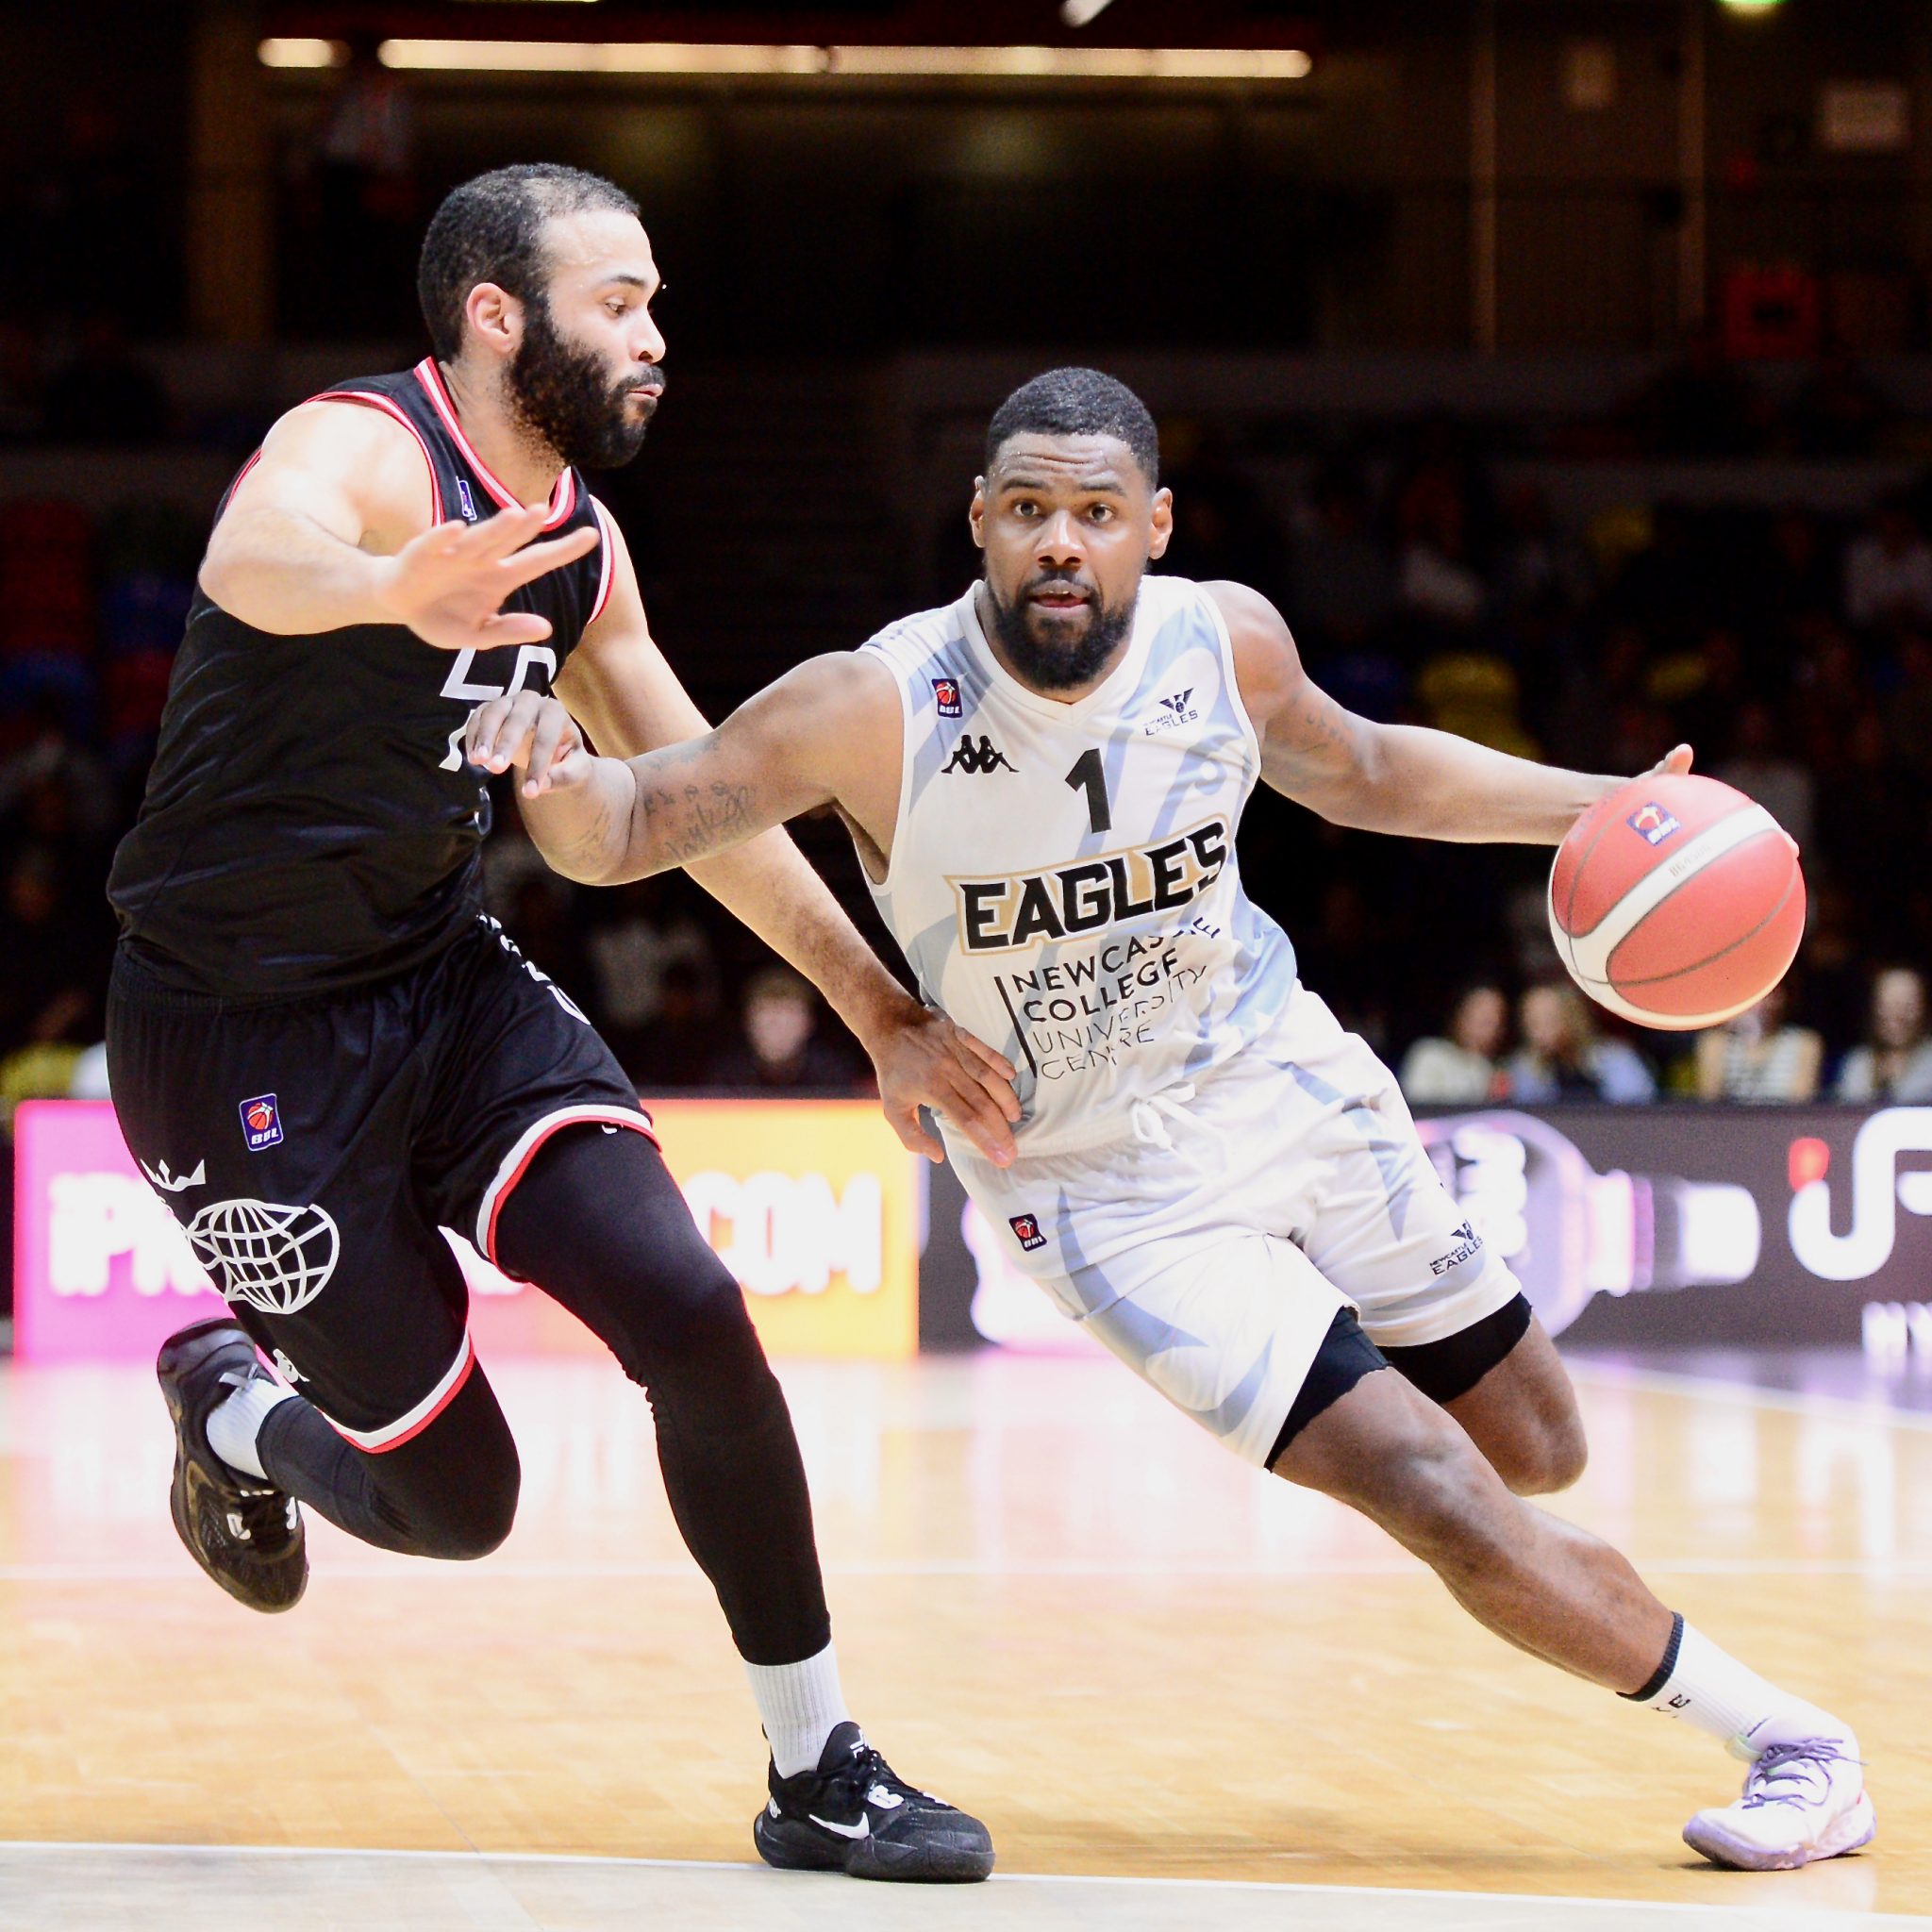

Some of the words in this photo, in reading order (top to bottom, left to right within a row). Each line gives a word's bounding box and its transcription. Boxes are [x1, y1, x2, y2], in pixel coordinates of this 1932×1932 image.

[1065, 748, 1112, 834] 1
[959, 821, 1228, 950] EAGLES
[251, 1127, 279, 1145] BBL
[1432, 1236, 1483, 1275] EAGLES
